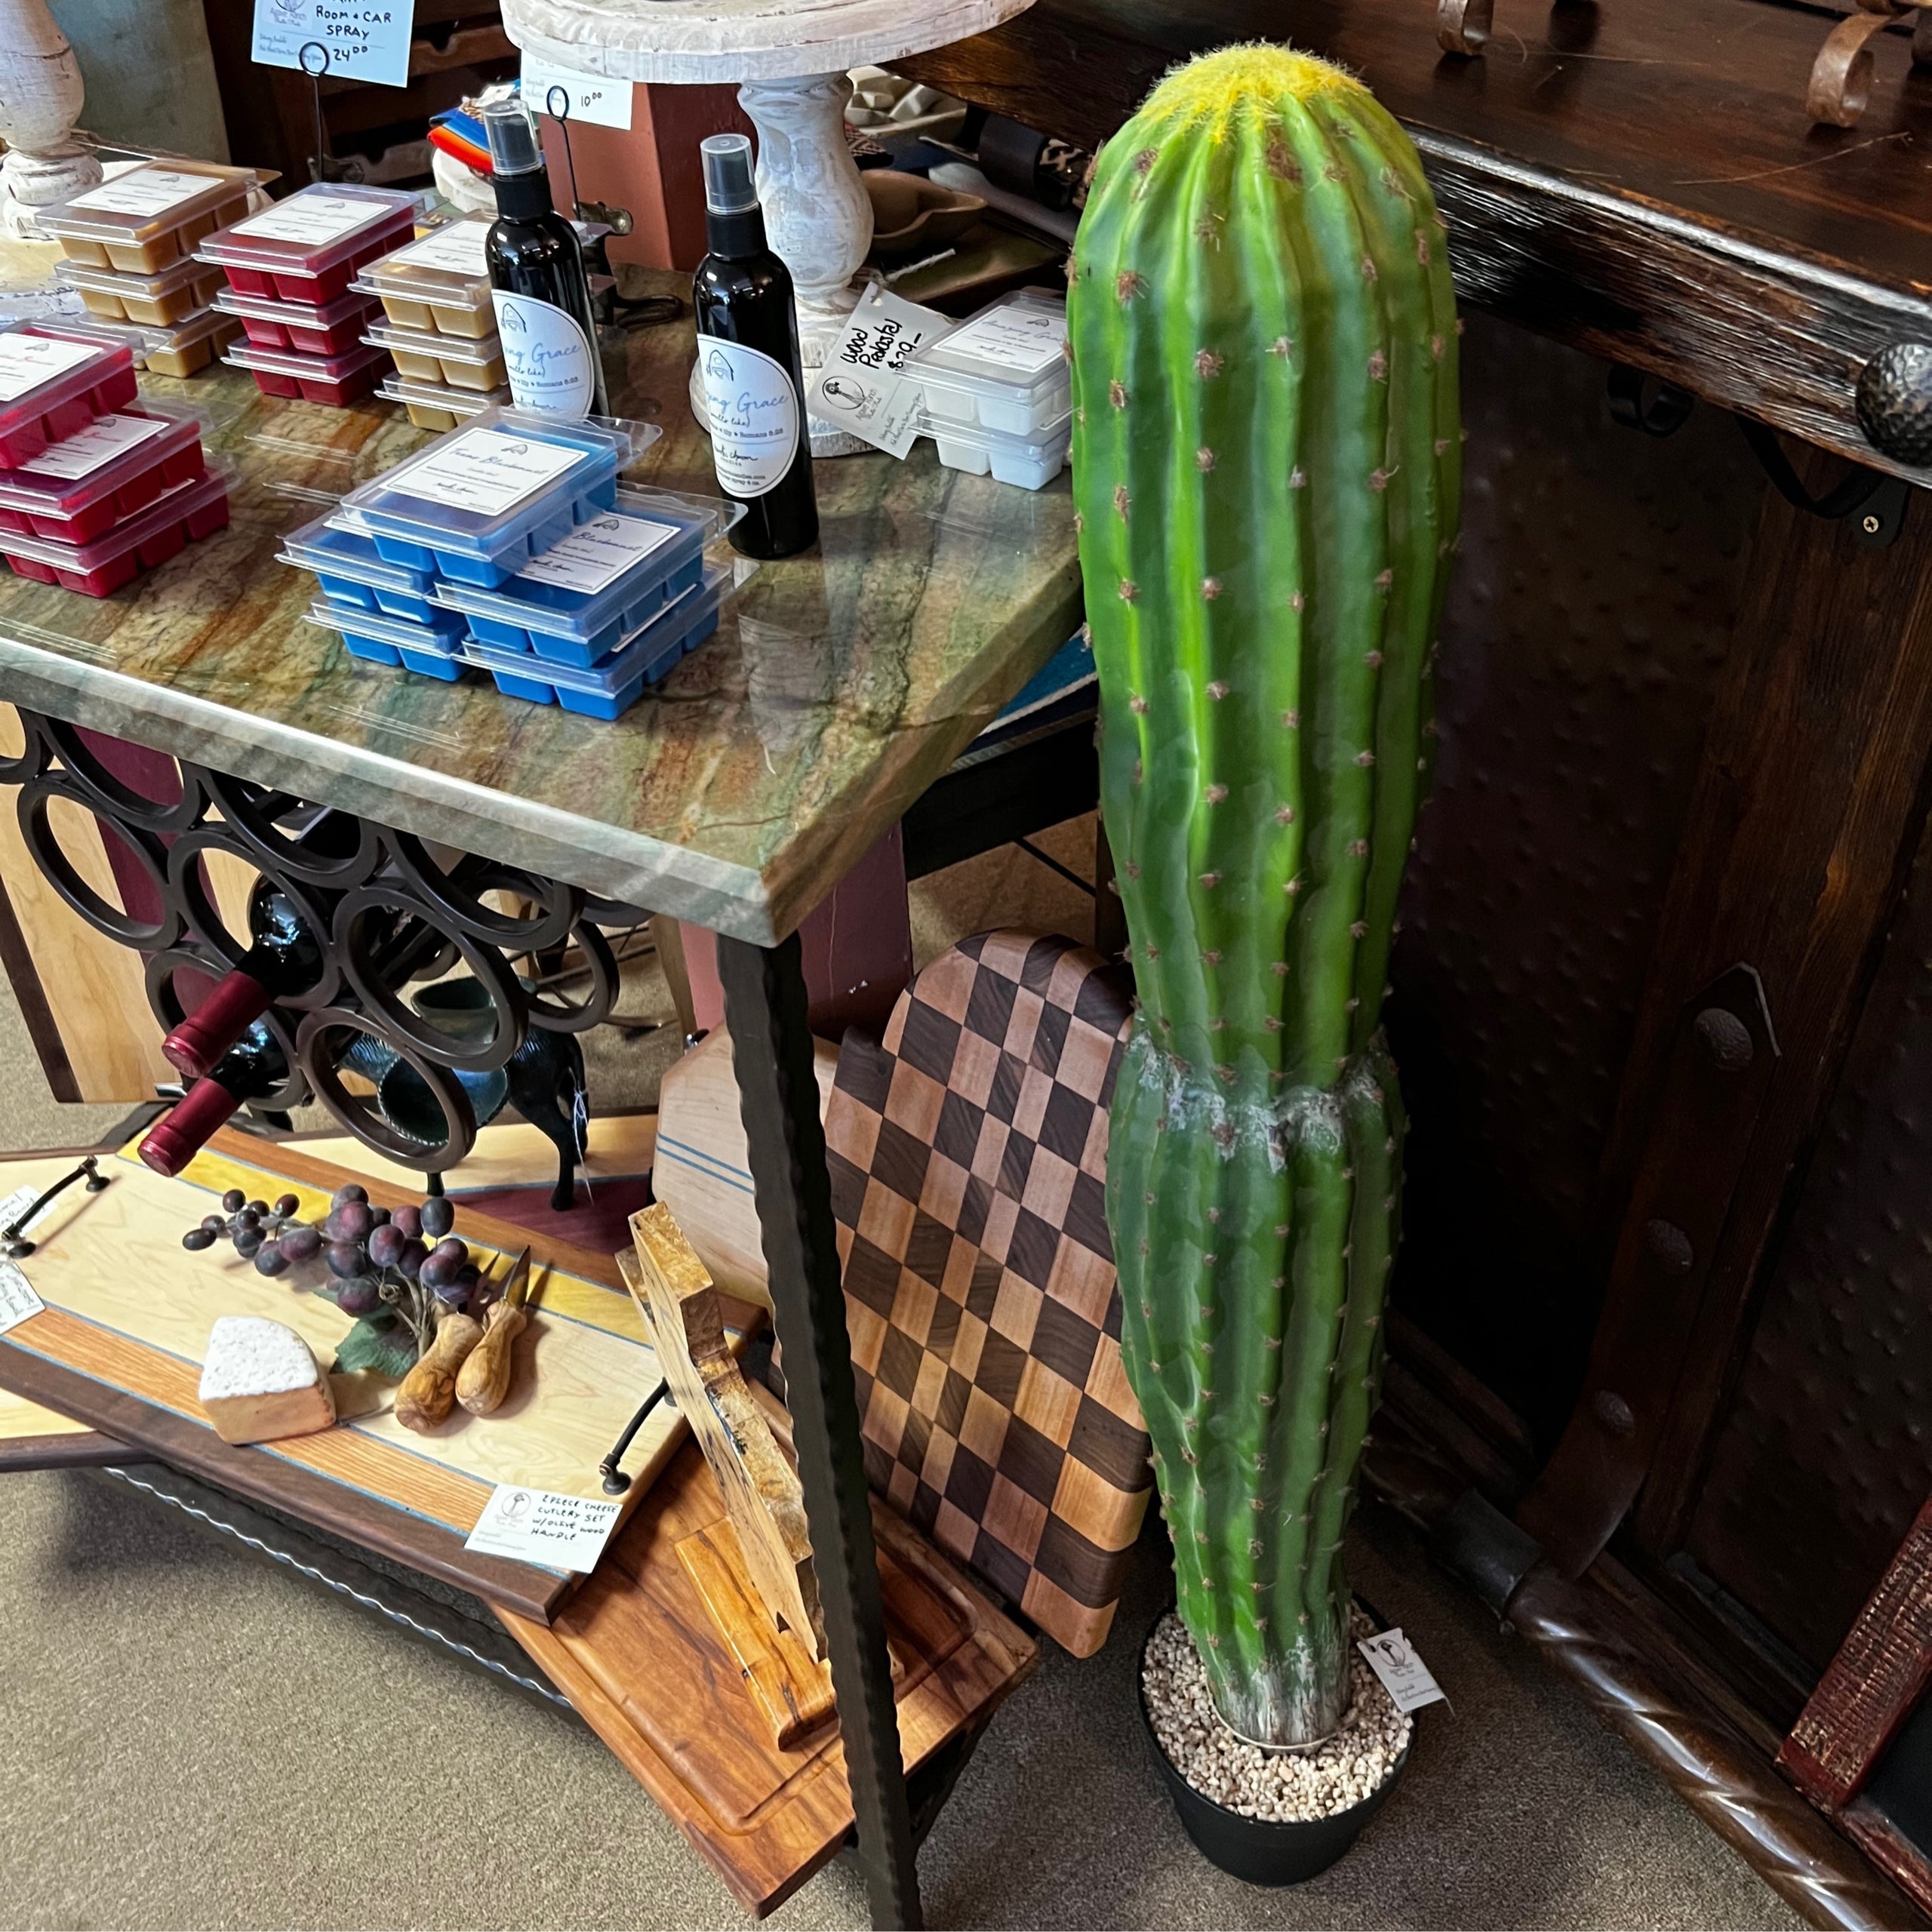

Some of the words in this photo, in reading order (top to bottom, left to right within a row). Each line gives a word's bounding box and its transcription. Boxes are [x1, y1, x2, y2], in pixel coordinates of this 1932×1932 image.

[364, 11, 392, 23] CAR
[531, 343, 581, 367] Grace
[737, 392, 789, 415] Grace
[584, 1513, 606, 1523] SET
